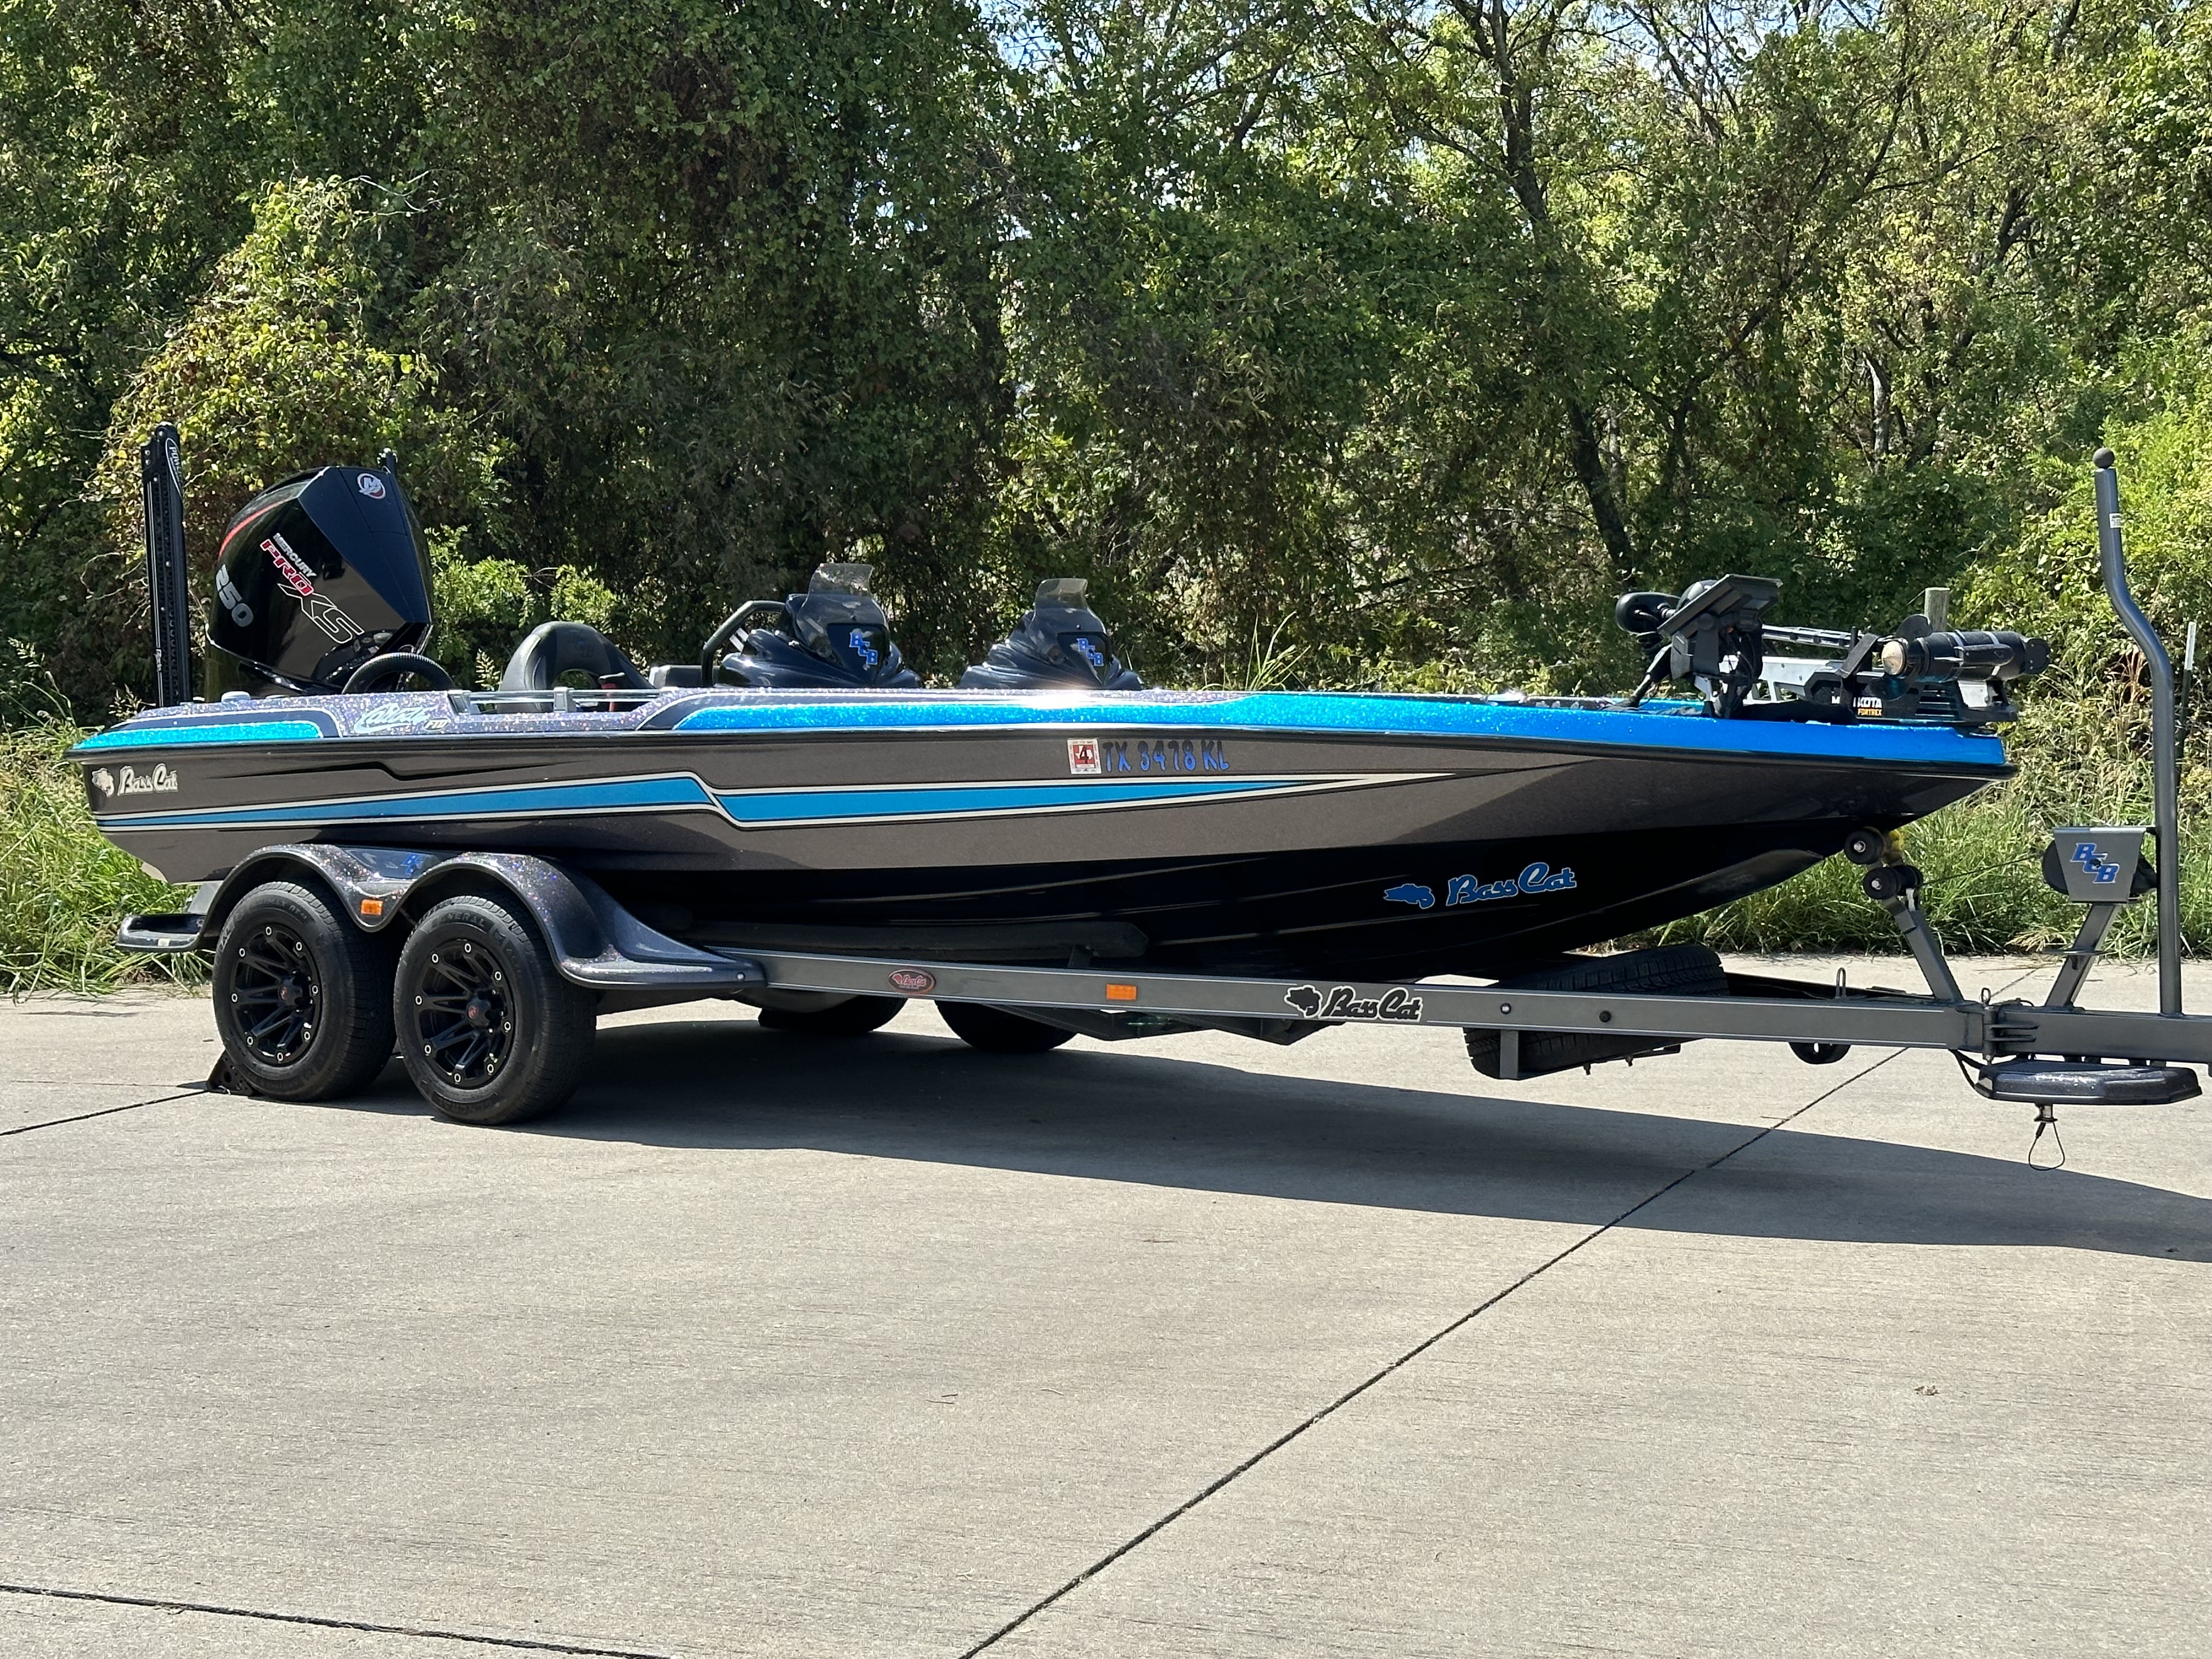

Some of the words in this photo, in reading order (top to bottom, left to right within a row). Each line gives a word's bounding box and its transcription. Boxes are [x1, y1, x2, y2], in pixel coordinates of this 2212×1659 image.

[259, 539, 314, 596] PRO
[273, 533, 317, 577] MERCURY
[216, 563, 253, 628] 250
[277, 583, 365, 644] XS
[1857, 697, 1882, 708] KOTA
[1079, 746, 1089, 764] 4
[1103, 741, 1131, 772] TX
[1137, 740, 1196, 771] 3478
[1201, 740, 1229, 771] KL
[117, 766, 153, 796] Bass
[153, 763, 178, 792] Cat
[1446, 874, 1518, 906] Bass
[1518, 862, 1577, 893] Cat
[1318, 986, 1379, 1020] Bass
[1379, 987, 1423, 1022] Cat
